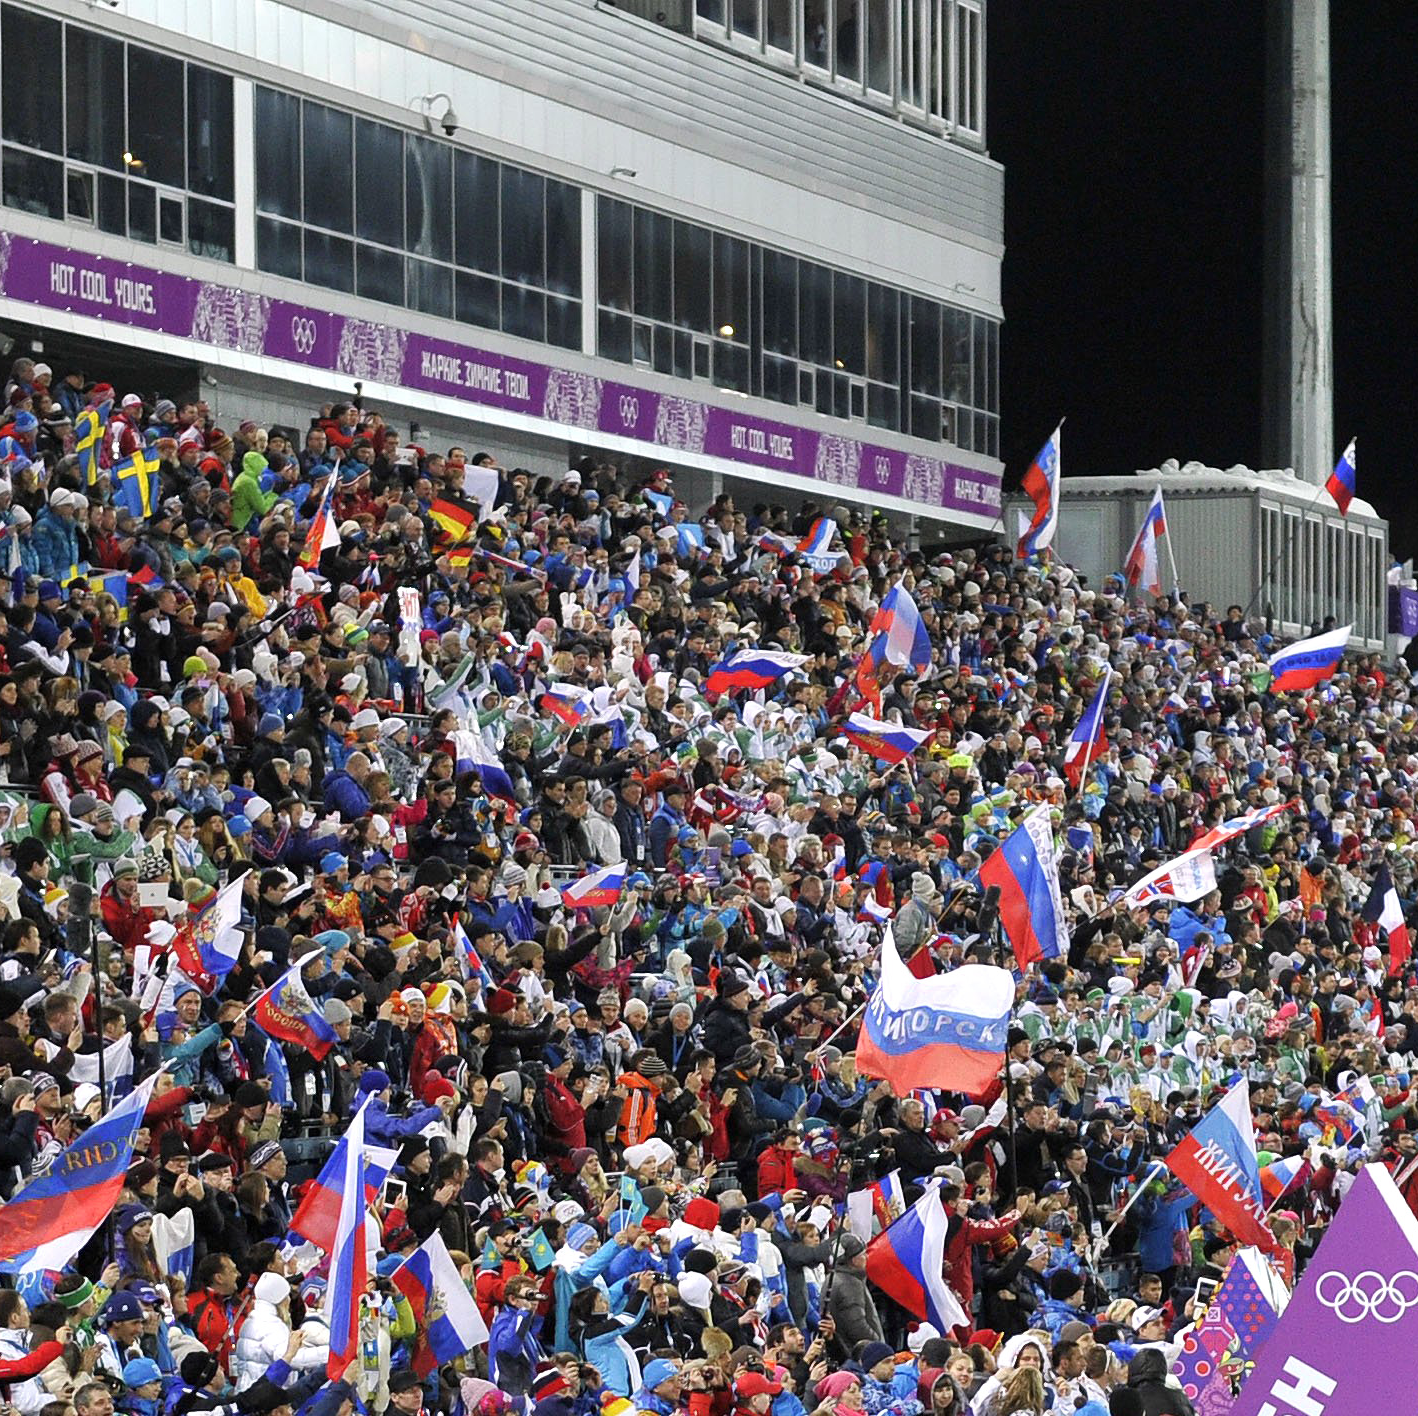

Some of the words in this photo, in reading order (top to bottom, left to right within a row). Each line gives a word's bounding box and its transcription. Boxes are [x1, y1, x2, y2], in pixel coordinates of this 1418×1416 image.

[50, 261, 77, 296] HOT.
[80, 269, 113, 304] COOL.
[114, 277, 157, 315] YOURS.
[421, 350, 463, 385] ЖАРКИЕ.
[504, 370, 531, 400] ТВОИ.
